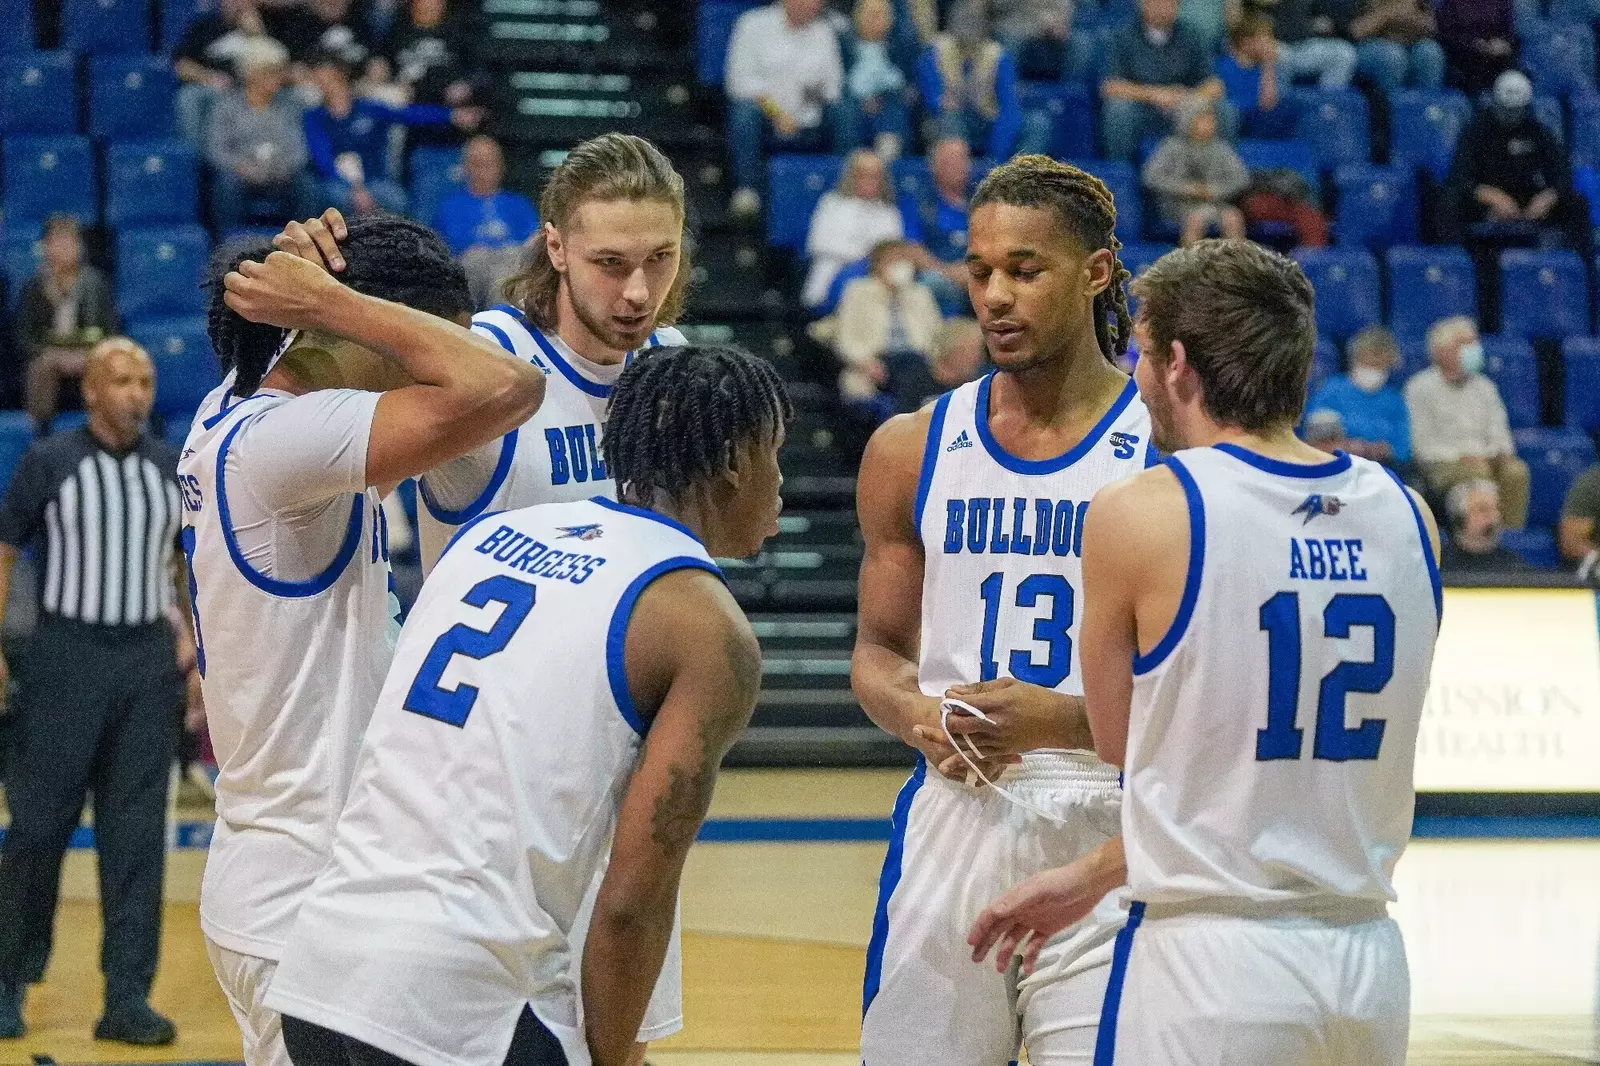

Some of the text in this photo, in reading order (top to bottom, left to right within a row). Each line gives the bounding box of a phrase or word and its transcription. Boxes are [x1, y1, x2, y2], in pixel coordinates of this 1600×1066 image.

[544, 422, 608, 485] BUL
[947, 441, 973, 452] adidas
[474, 524, 606, 584] BURGESS
[1290, 537, 1367, 580] ABEE
[402, 574, 536, 729] 2
[979, 571, 1074, 688] 13
[1255, 591, 1396, 761] 12
